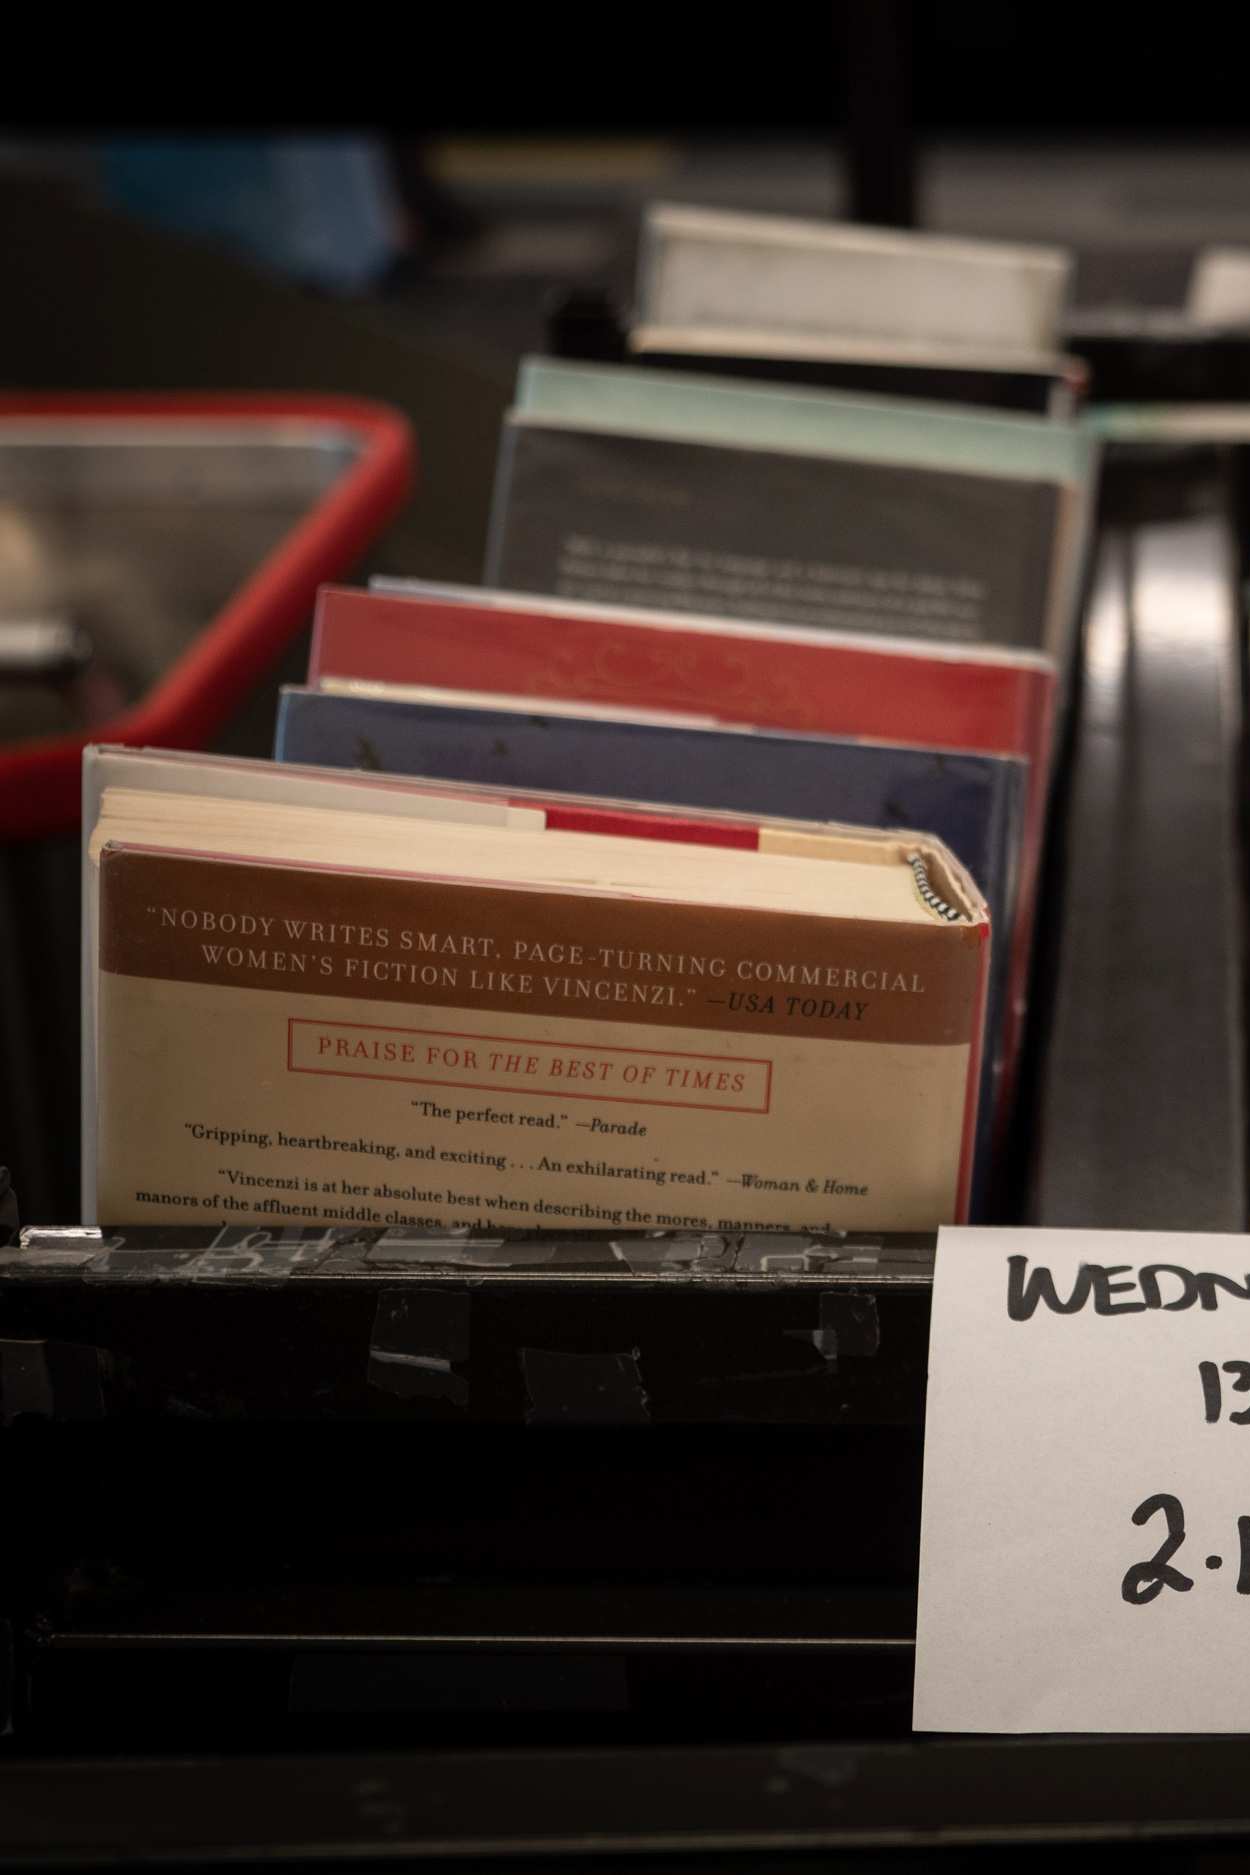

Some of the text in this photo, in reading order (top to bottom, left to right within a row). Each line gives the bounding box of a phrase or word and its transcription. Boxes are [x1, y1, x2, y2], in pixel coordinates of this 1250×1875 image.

[201, 944, 334, 976] WOMEN’S
[345, 958, 458, 987] FICTION
[470, 970, 533, 995] LIKE
[785, 997, 870, 1021] TODAY
[284, 919, 390, 948] WRITES
[400, 931, 501, 960] SMART,
[514, 942, 727, 977] PAGE-TURNING
[736, 960, 926, 994] COMMERCIAL
[318, 1036, 746, 1093] PRAISE FOR THE BEST OF TIMES
[456, 1104, 516, 1127] perfect
[277, 1131, 402, 1160] heartbreaking,
[404, 1144, 436, 1161] and
[439, 1148, 507, 1171] exciting
[538, 1156, 562, 1173] An
[565, 1161, 666, 1186] exhilarating
[804, 1178, 819, 1194] &
[823, 1180, 869, 1197] Home
[135, 1191, 199, 1209] manors
[202, 1193, 222, 1211] of
[222, 1196, 250, 1214] the
[253, 1199, 319, 1219] affluent
[322, 1204, 382, 1224] middle
[303, 1176, 319, 1193] is
[321, 1180, 338, 1195] at
[341, 1180, 369, 1198] her
[373, 1184, 443, 1204] absolute
[446, 1189, 481, 1208] best
[484, 1195, 530, 1213] when
[533, 1199, 622, 1226] describing
[625, 1207, 653, 1225] the
[655, 1213, 713, 1230] mores,
